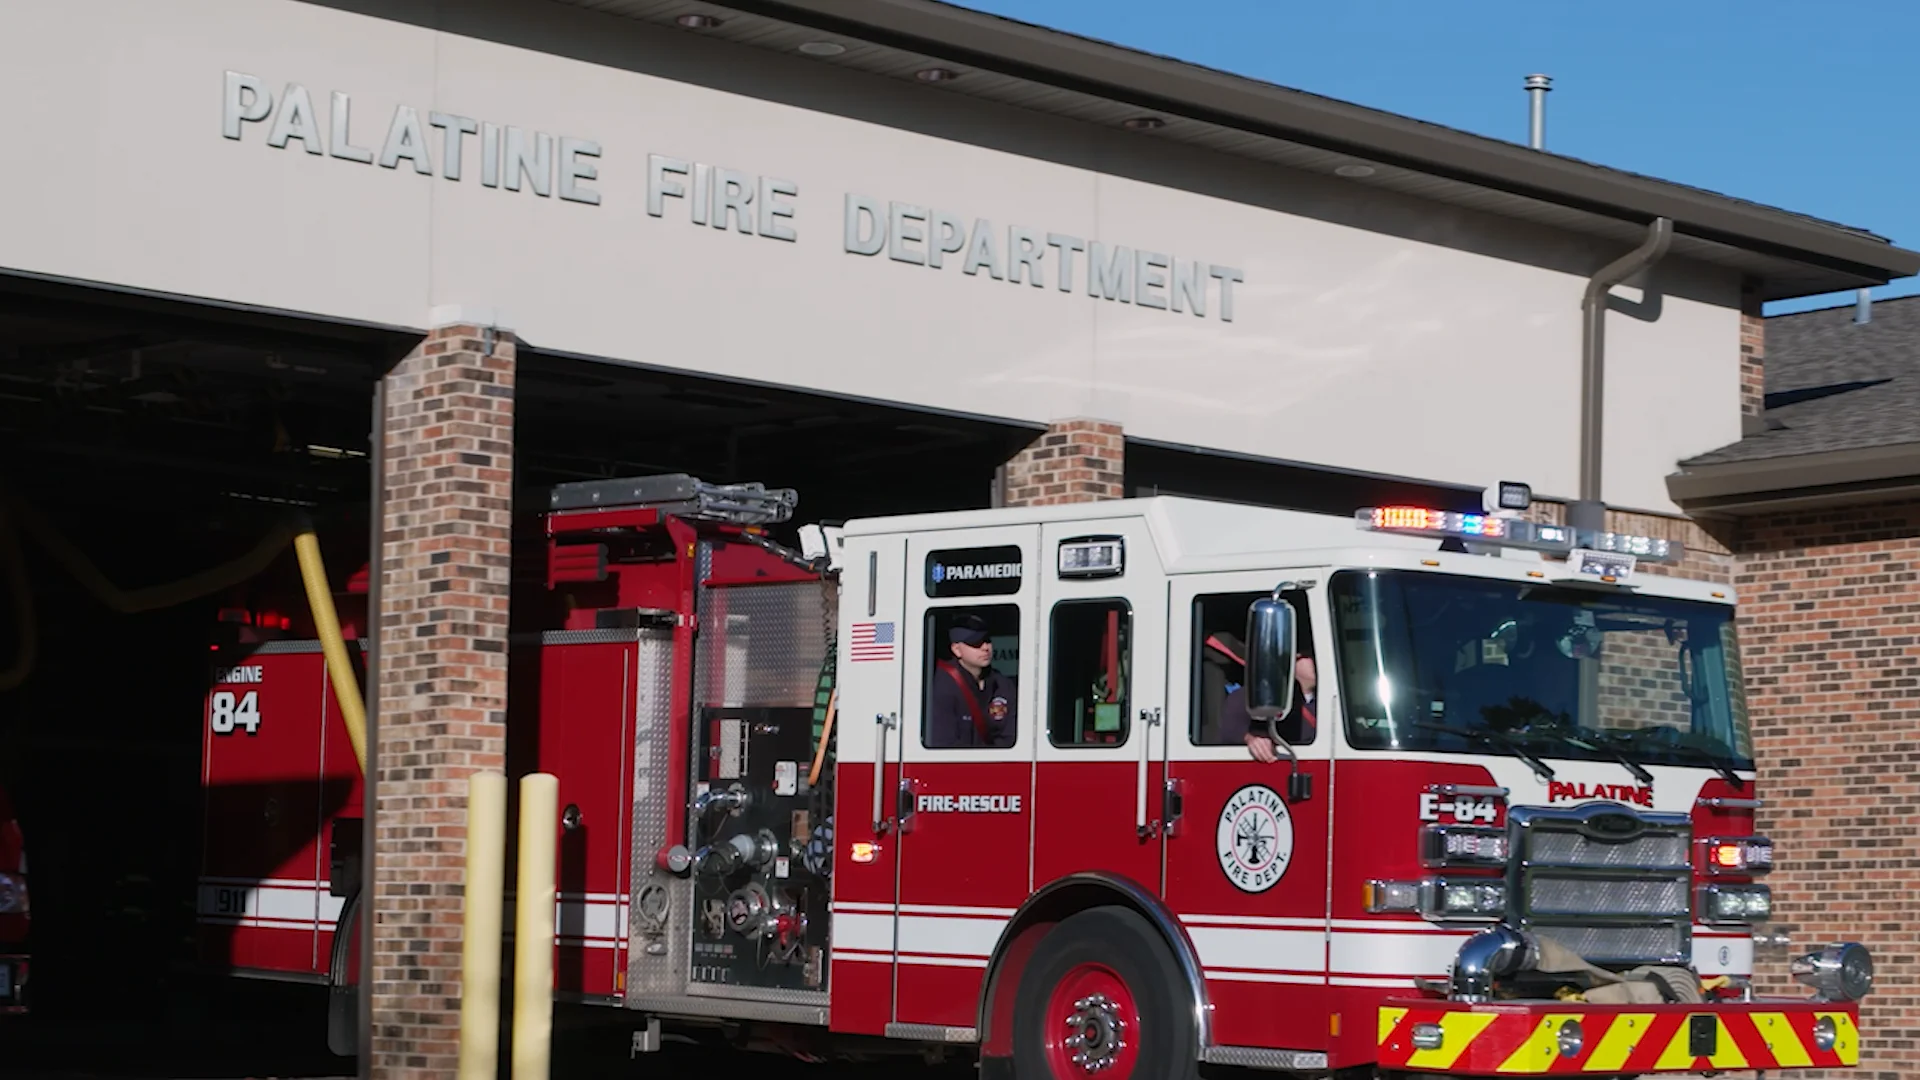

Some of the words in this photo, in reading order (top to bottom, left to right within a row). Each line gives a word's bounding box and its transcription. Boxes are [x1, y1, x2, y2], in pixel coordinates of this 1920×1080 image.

[222, 69, 601, 206] PALATINE
[647, 153, 798, 242] FIRE
[844, 192, 1244, 322] DEPARTMENT
[215, 665, 263, 683] ENGINE
[212, 691, 261, 735] 84
[917, 794, 1021, 813] FIRE-RESCUE
[1224, 790, 1286, 823] PALATINE
[1419, 793, 1497, 823] E-84
[1548, 780, 1654, 808] PALATINE
[1223, 851, 1249, 885] FIRE
[1254, 851, 1287, 886] DEPT.
